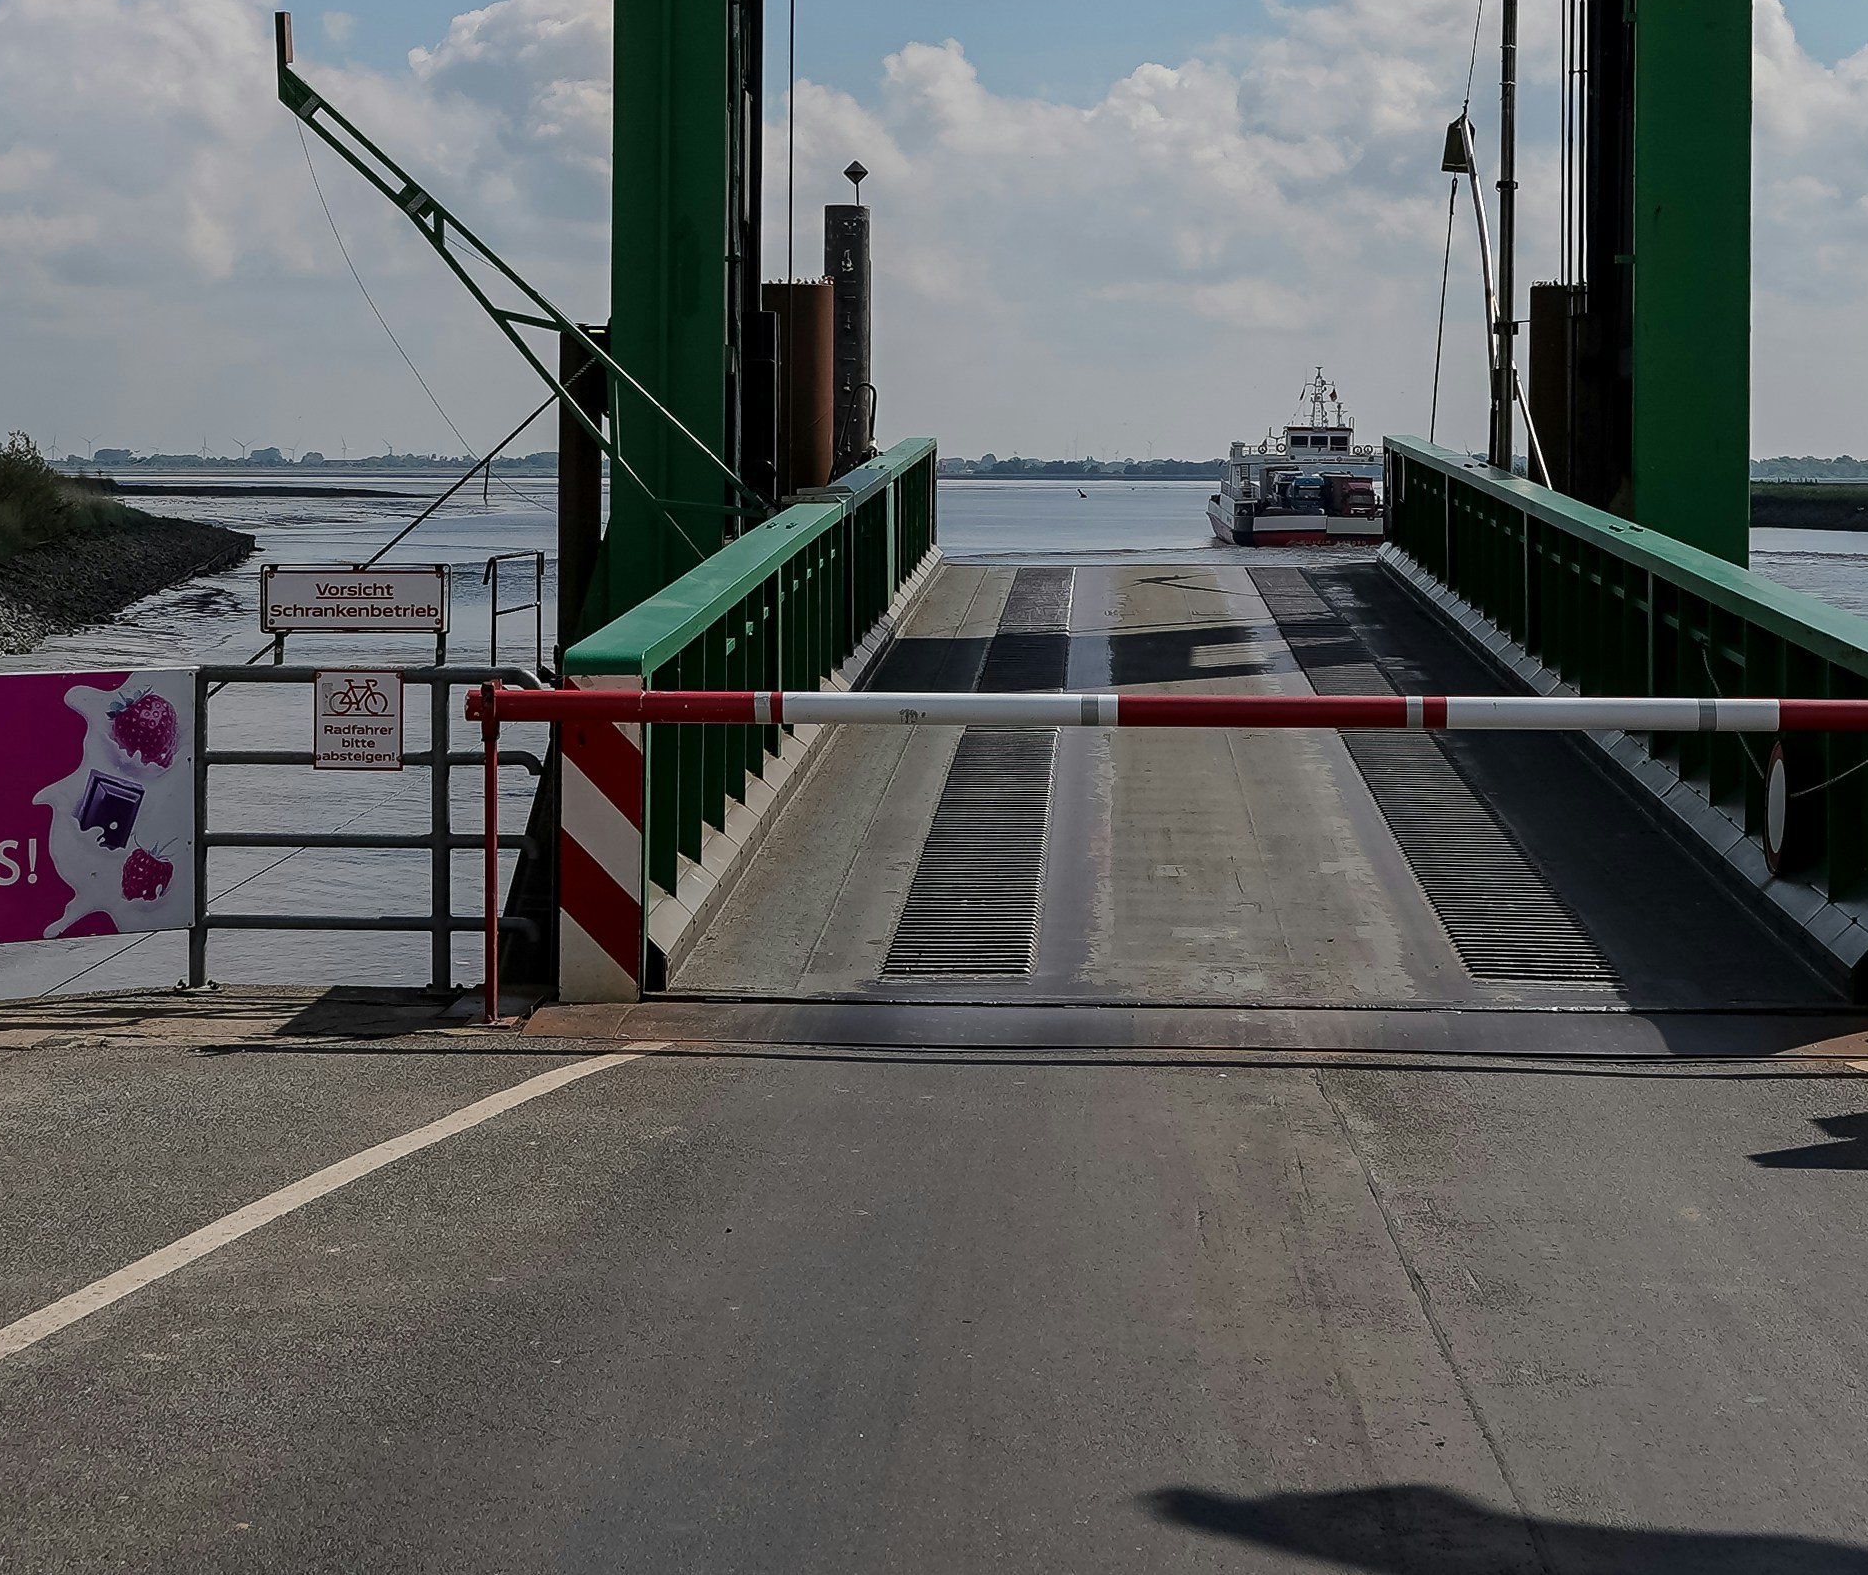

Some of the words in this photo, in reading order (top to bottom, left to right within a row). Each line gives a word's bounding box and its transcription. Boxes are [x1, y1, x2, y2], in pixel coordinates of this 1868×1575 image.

[315, 583, 394, 596] Vorsicht
[270, 604, 439, 617] Schrankenbetrieb
[324, 724, 394, 735] Radfahrer
[341, 738, 375, 748] bitte
[322, 751, 395, 764] absteigen!
